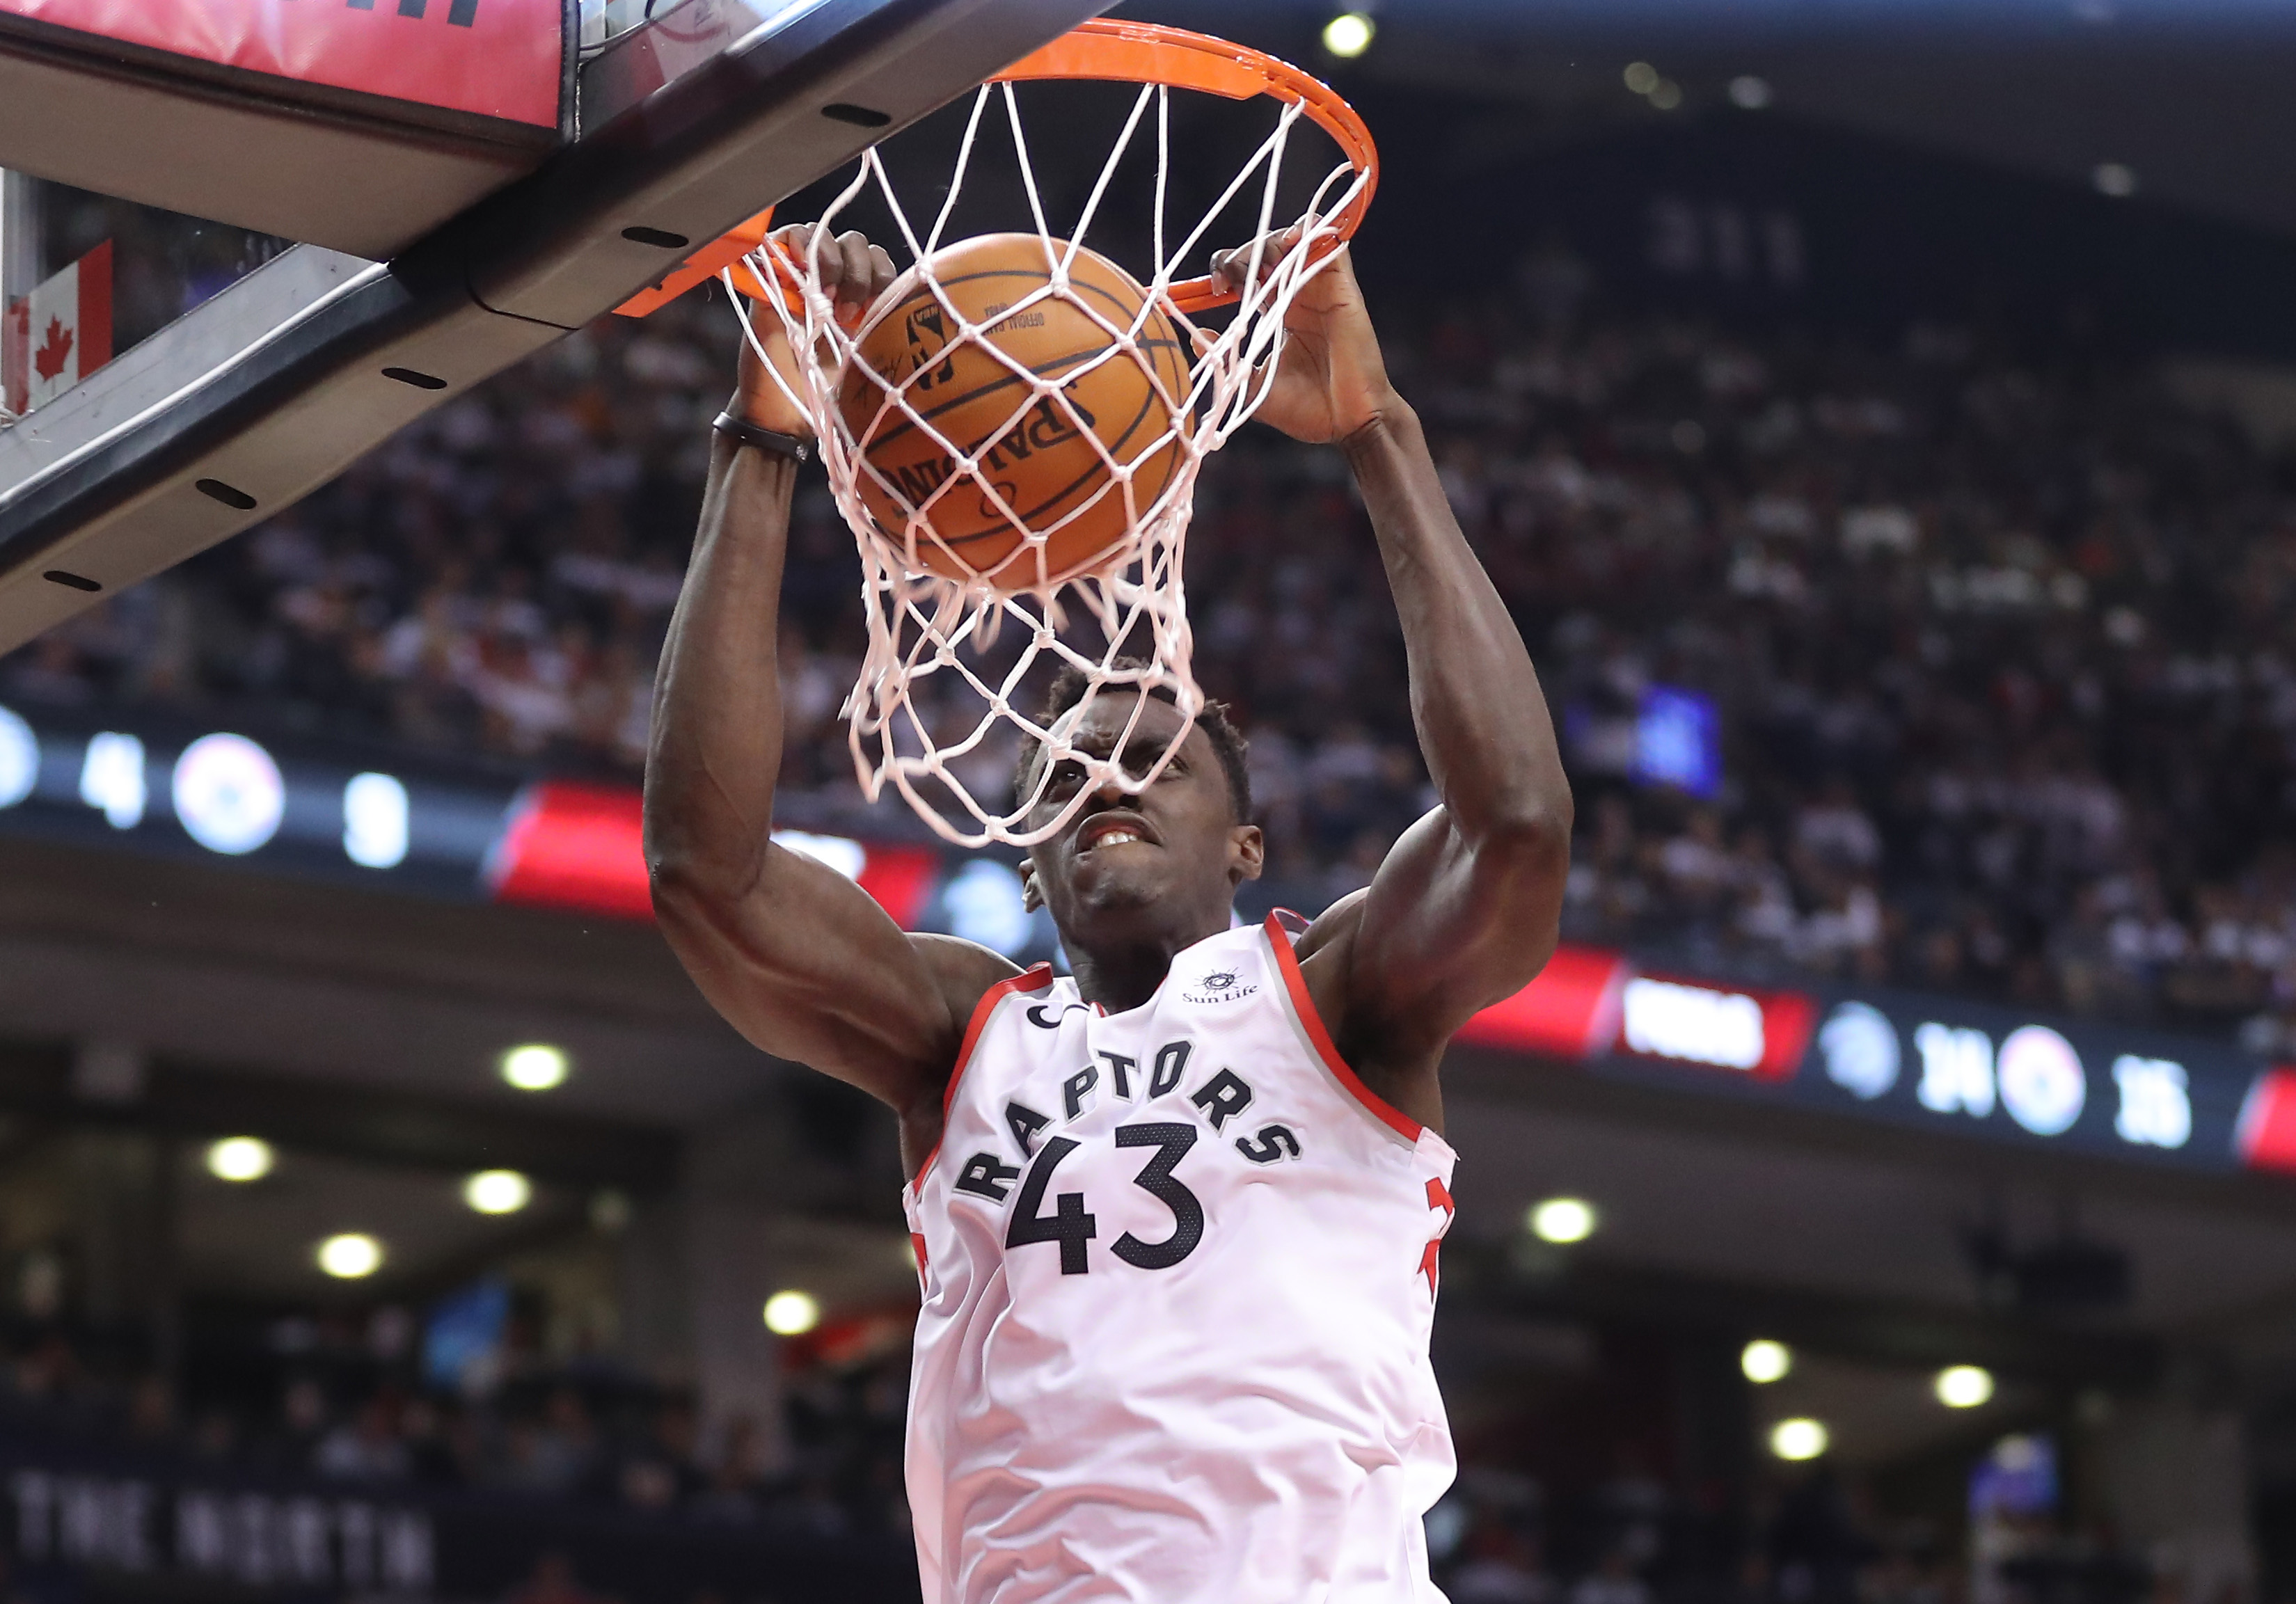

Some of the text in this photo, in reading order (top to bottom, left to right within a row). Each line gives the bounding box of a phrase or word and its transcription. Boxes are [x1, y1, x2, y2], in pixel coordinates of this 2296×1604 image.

[1182, 985, 1258, 1003] Sun Life
[953, 1040, 1304, 1207] RAPTORS
[1005, 1122, 1205, 1275] 43
